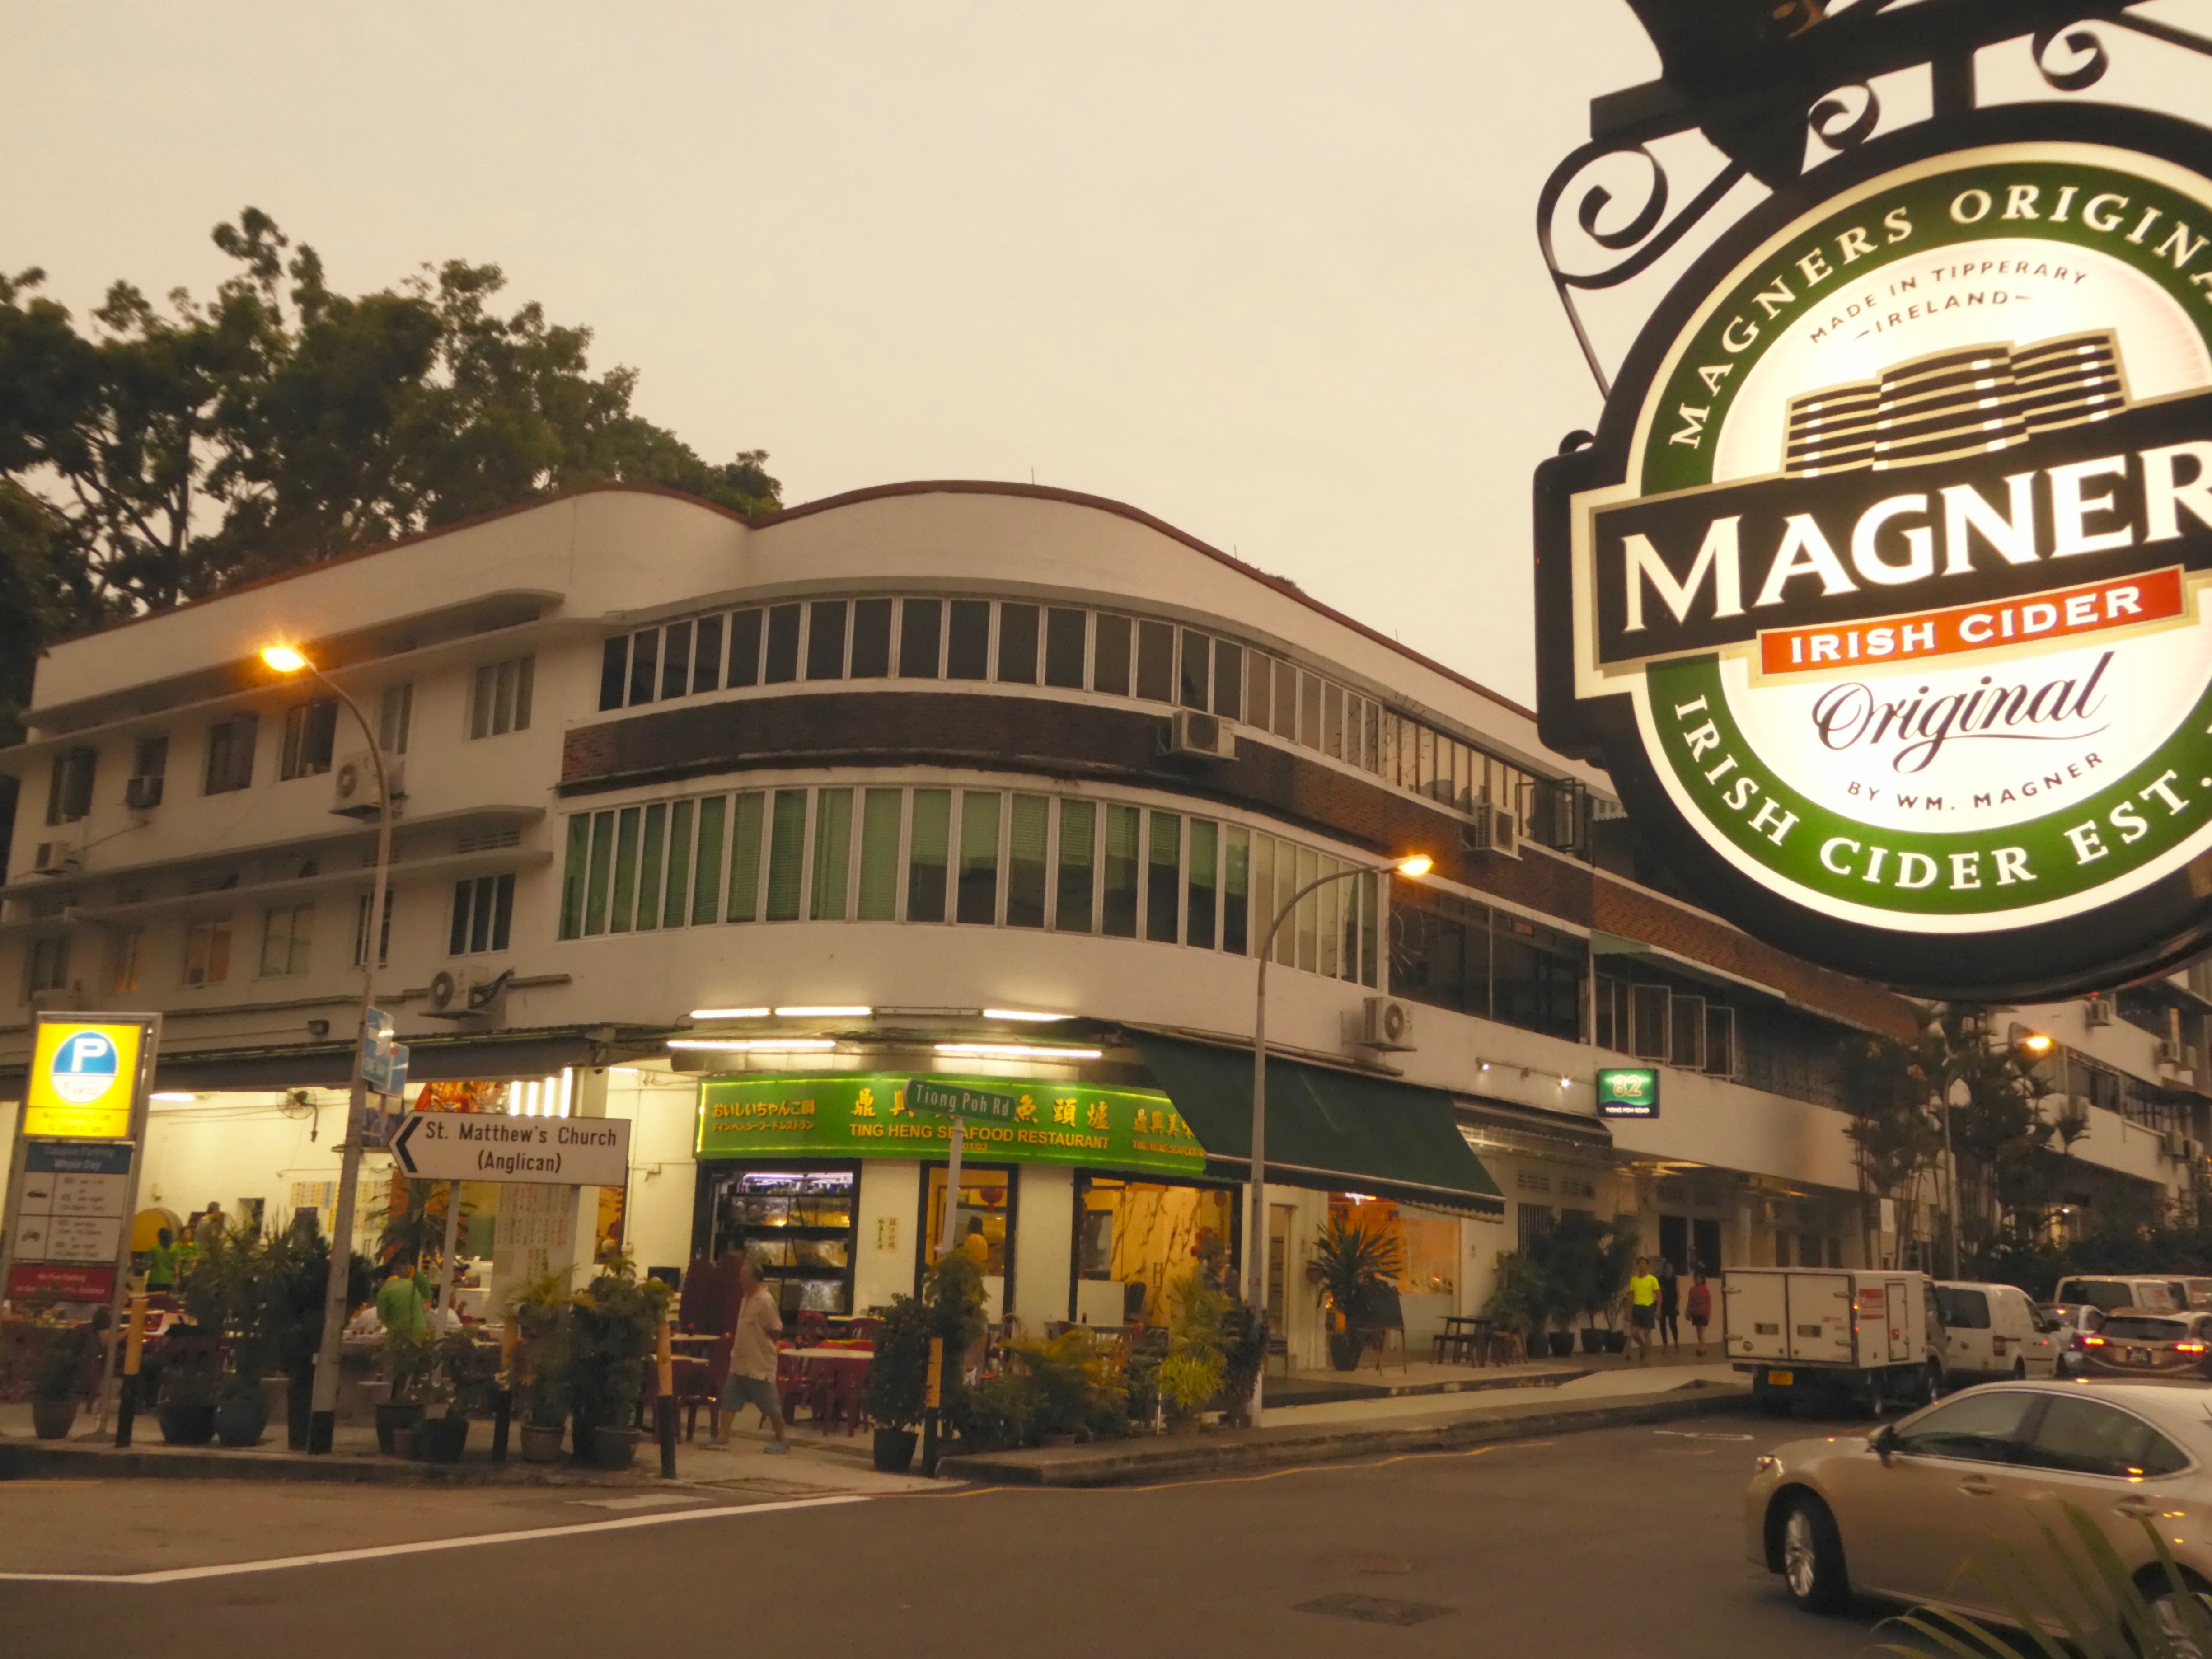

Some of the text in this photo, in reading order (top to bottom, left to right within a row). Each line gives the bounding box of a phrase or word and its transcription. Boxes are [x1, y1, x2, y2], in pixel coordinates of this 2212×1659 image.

[1669, 206, 1913, 449] MAGNERS
[1809, 260, 2088, 345] MADE IN TIPPERARY
[1875, 290, 2009, 333] IRELAND
[1622, 440, 2212, 631] MAGNER
[1790, 586, 2142, 664] IRISH CIDER
[1812, 651, 2115, 773] Original
[1674, 694, 2212, 889] IRISH CIDER EST.
[1848, 752, 2104, 811] BY WM. MAGNER
[917, 1084, 1009, 1117] Tiong Poh Rd
[1612, 1074, 1642, 1097] 82
[425, 1121, 616, 1147] St. Matthew's Church
[478, 1149, 562, 1174] (Anglican)
[849, 1123, 1110, 1149] TING HENG SEAFOOD RESTAURANT
